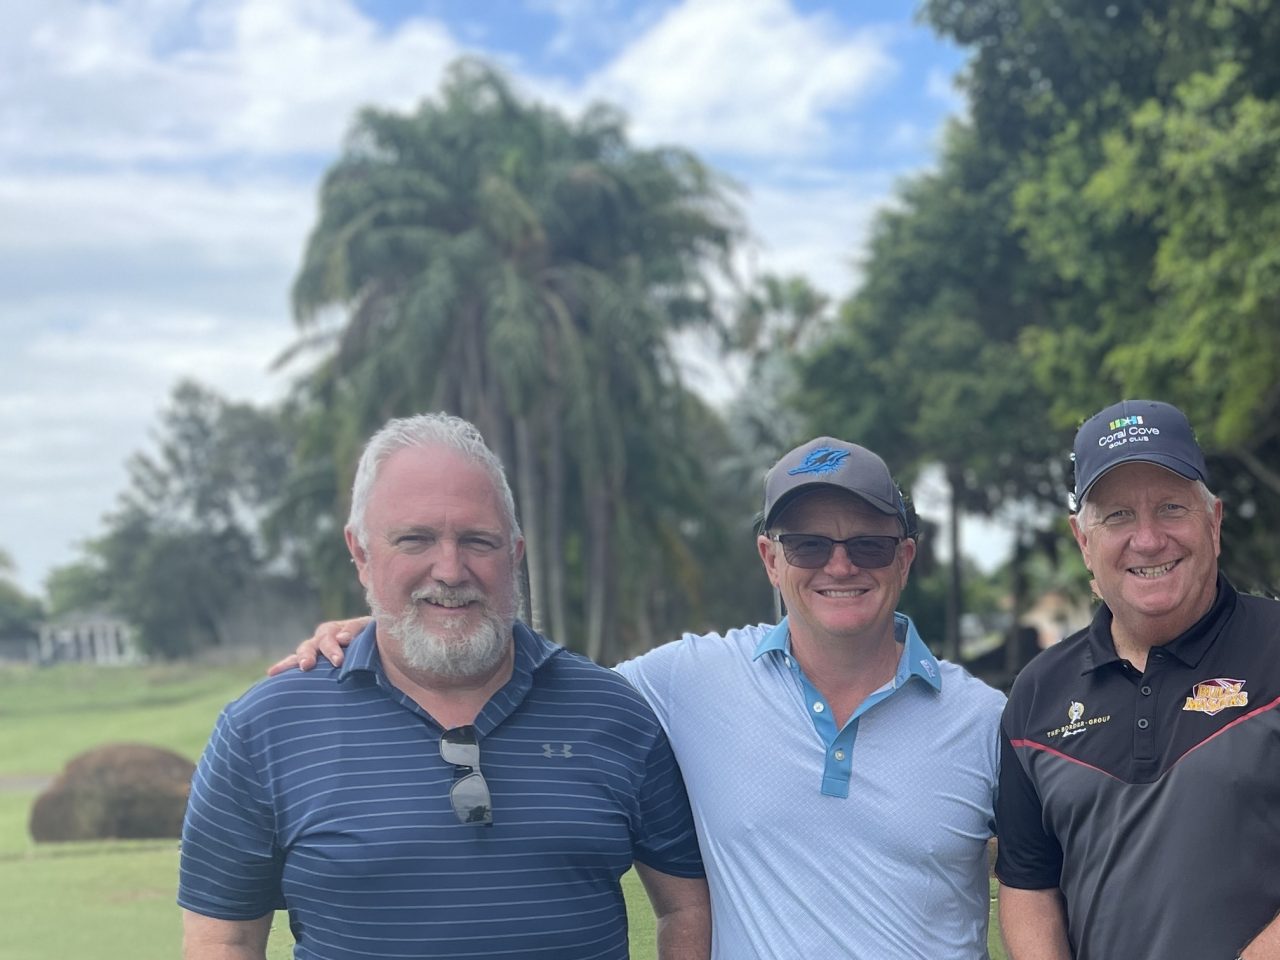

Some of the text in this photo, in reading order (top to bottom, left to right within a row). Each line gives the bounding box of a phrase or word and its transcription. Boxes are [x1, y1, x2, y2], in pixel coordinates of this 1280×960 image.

[1098, 426, 1160, 447] Coral Cove
[1108, 438, 1127, 449] GOLF
[1088, 715, 1111, 725] GROUP
